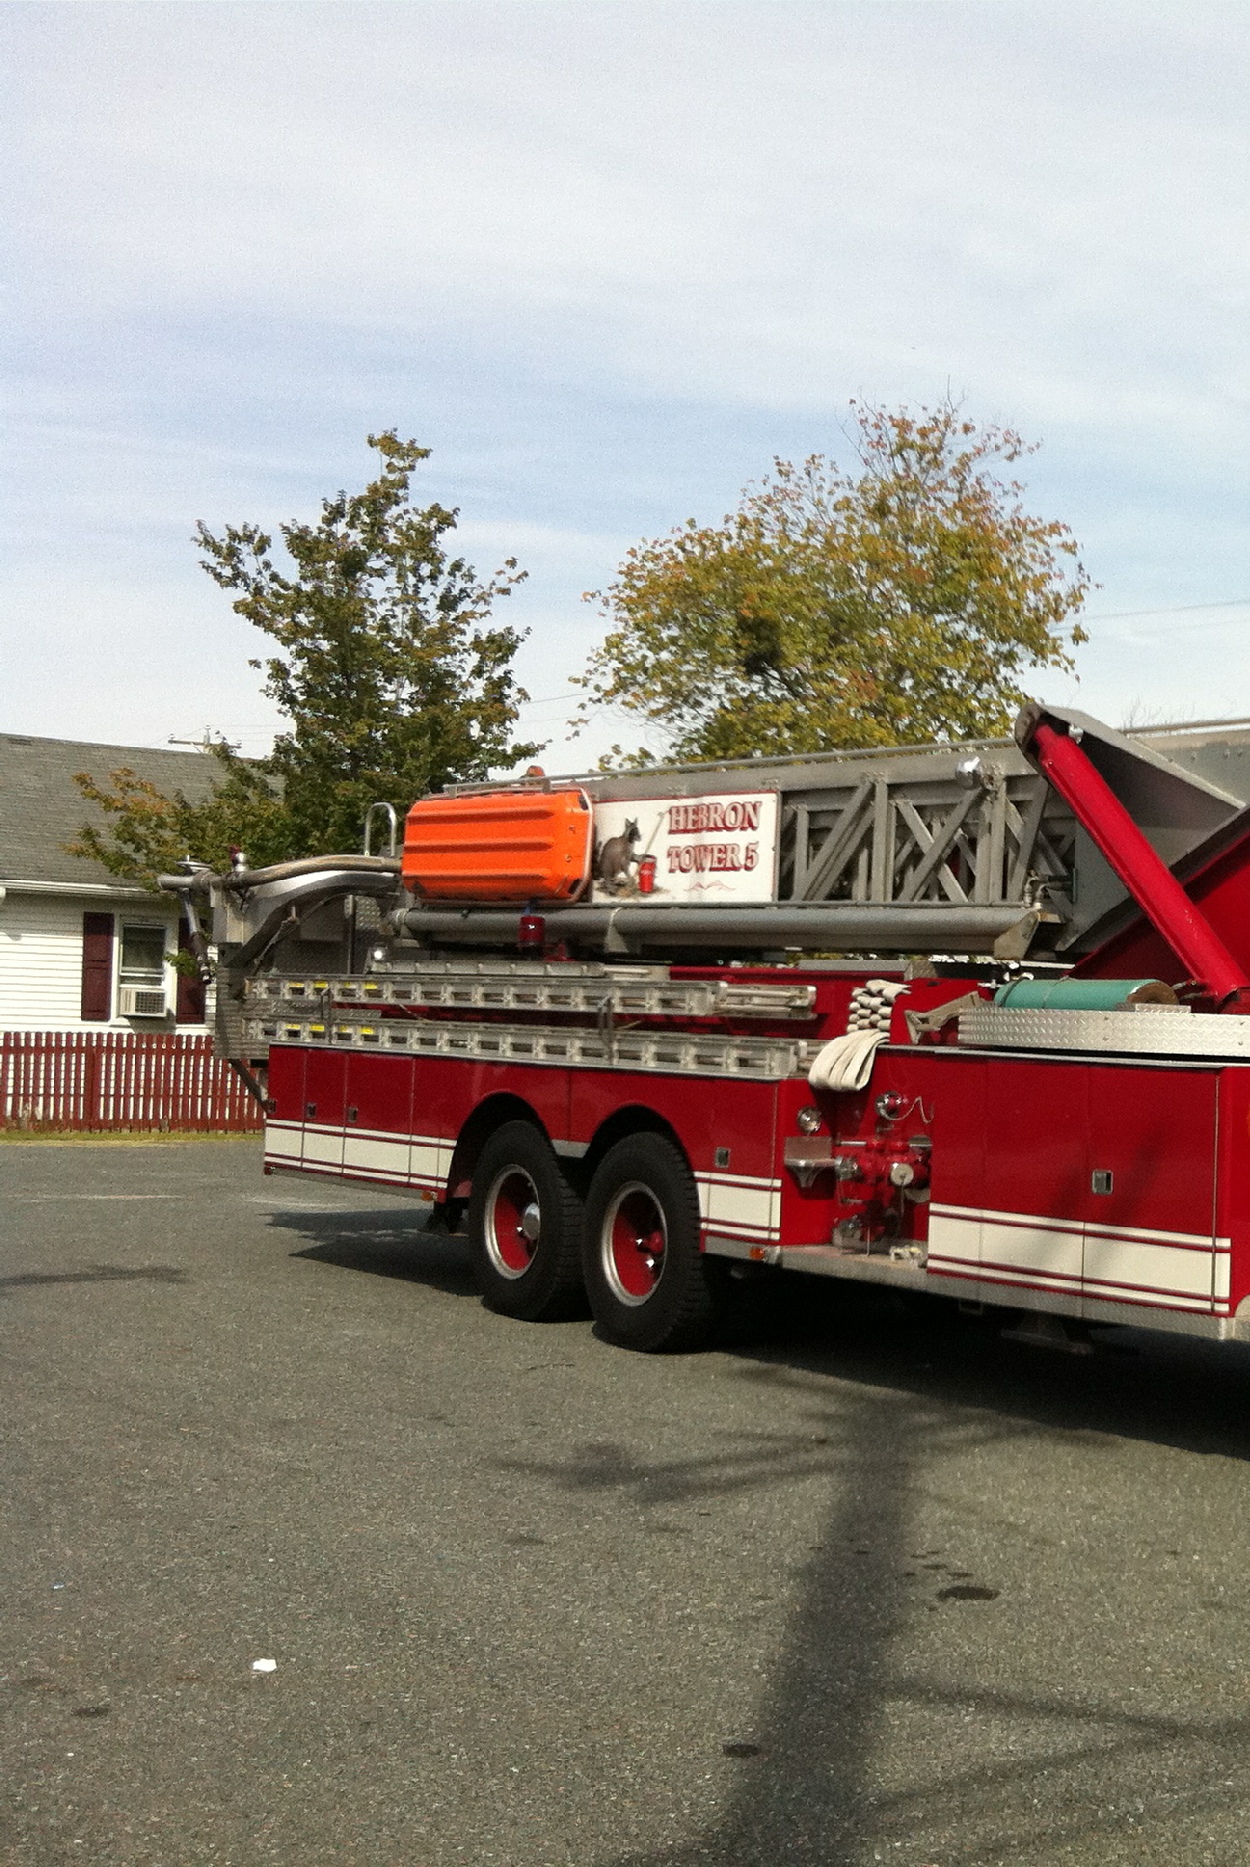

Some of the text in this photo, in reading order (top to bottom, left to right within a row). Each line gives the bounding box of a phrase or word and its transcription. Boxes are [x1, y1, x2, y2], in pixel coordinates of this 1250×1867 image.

[668, 801, 762, 834] HEBRON
[667, 841, 760, 873] TOWER 5
